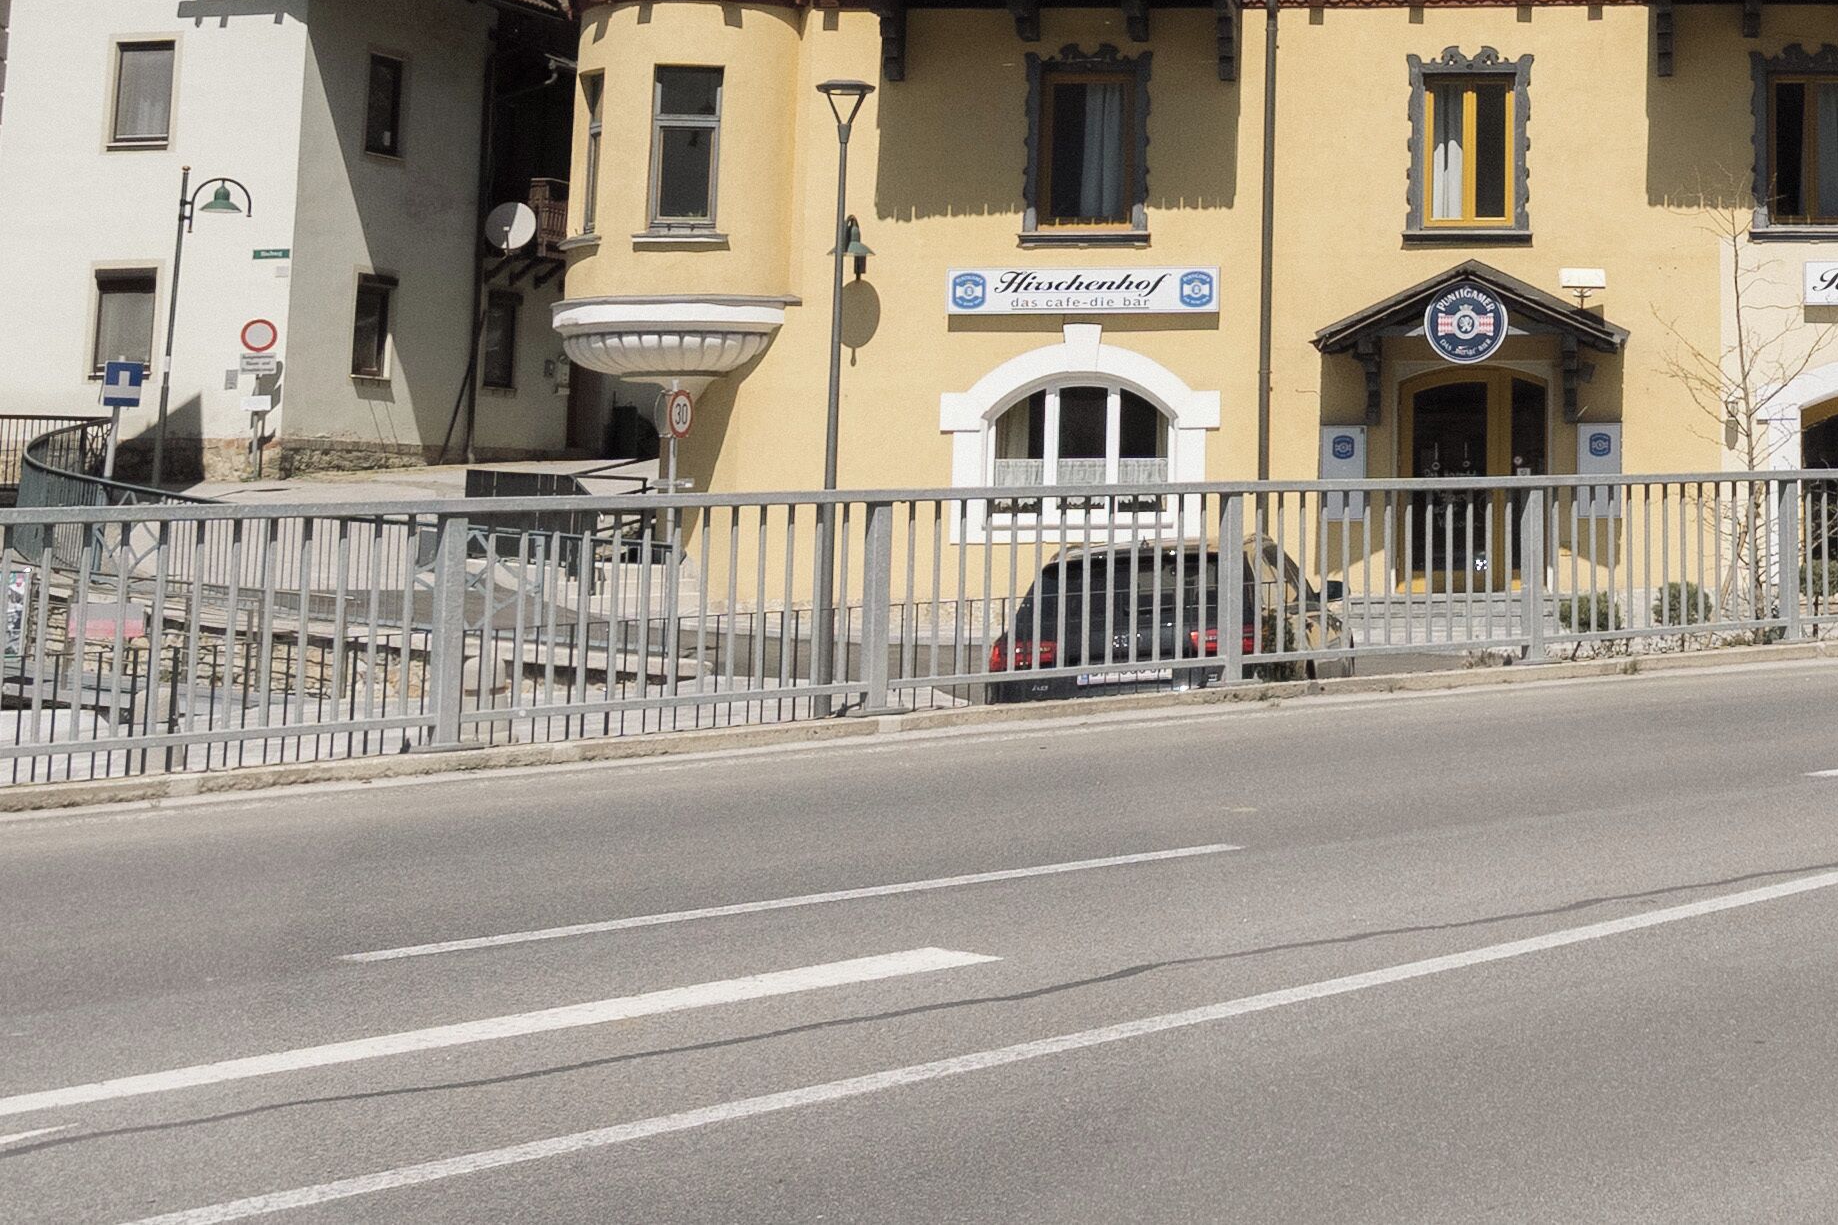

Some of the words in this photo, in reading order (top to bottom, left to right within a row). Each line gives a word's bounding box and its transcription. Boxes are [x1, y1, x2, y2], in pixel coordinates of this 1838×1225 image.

[994, 270, 1172, 297] Hirschenhof
[1010, 296, 1038, 308] das
[1122, 296, 1151, 307] bar
[1435, 287, 1496, 312] PUNTIGAMER
[674, 403, 689, 425] 30
